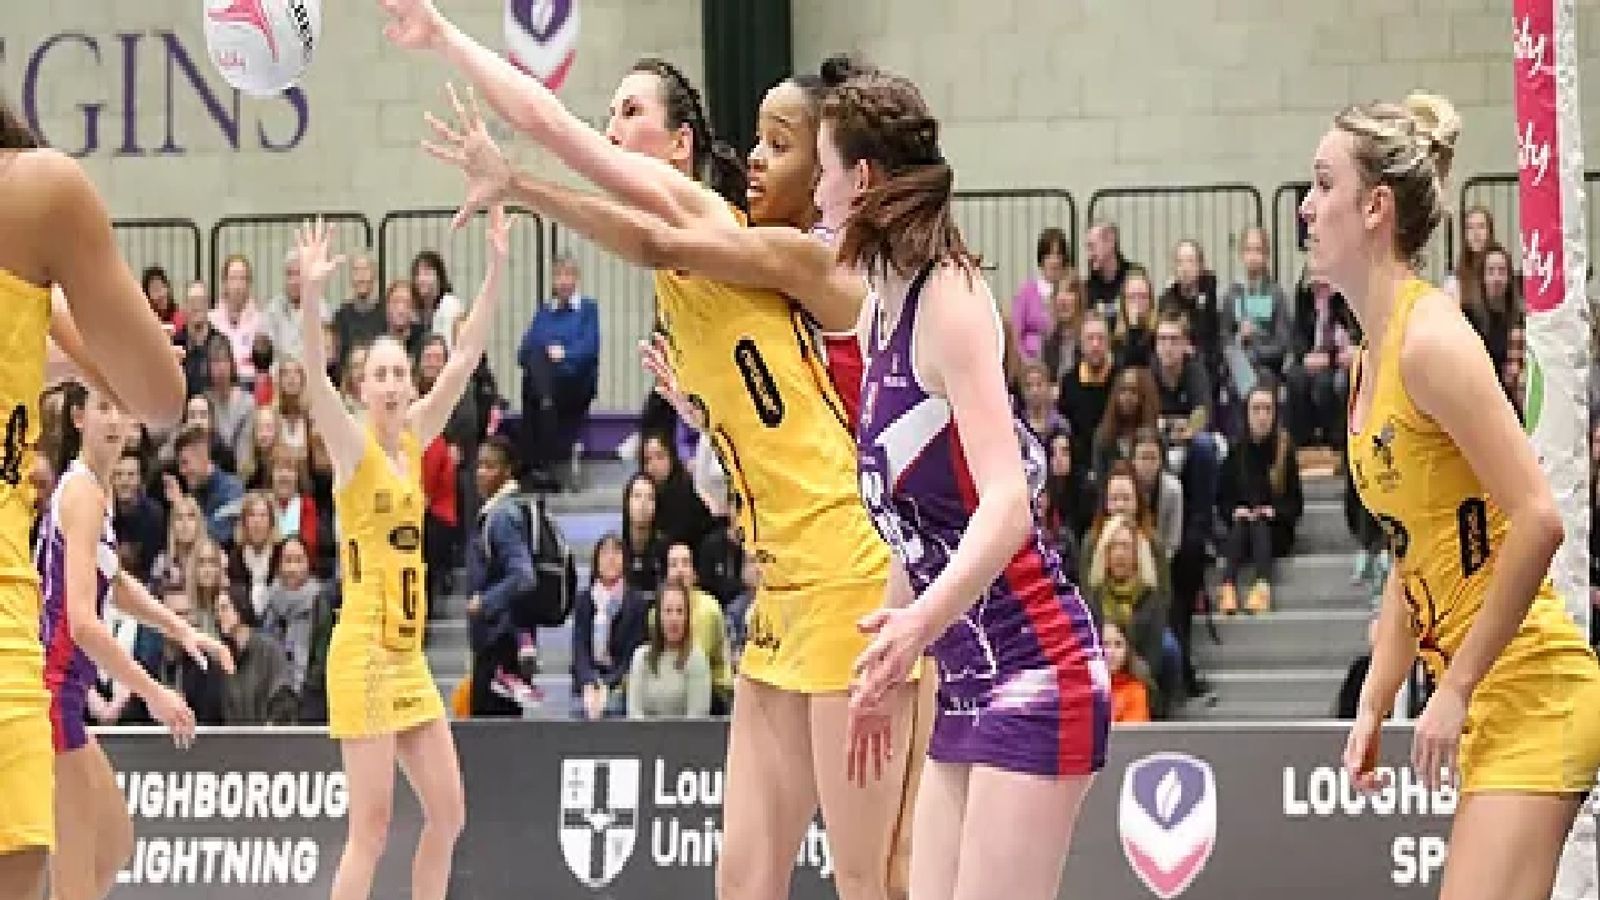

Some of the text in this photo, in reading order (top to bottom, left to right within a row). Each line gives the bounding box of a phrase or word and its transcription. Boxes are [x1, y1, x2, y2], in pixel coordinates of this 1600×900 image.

[0, 30, 310, 157] GINS
[116, 771, 349, 818] UGHBOROUG
[1282, 766, 1459, 815] LOUGHB
